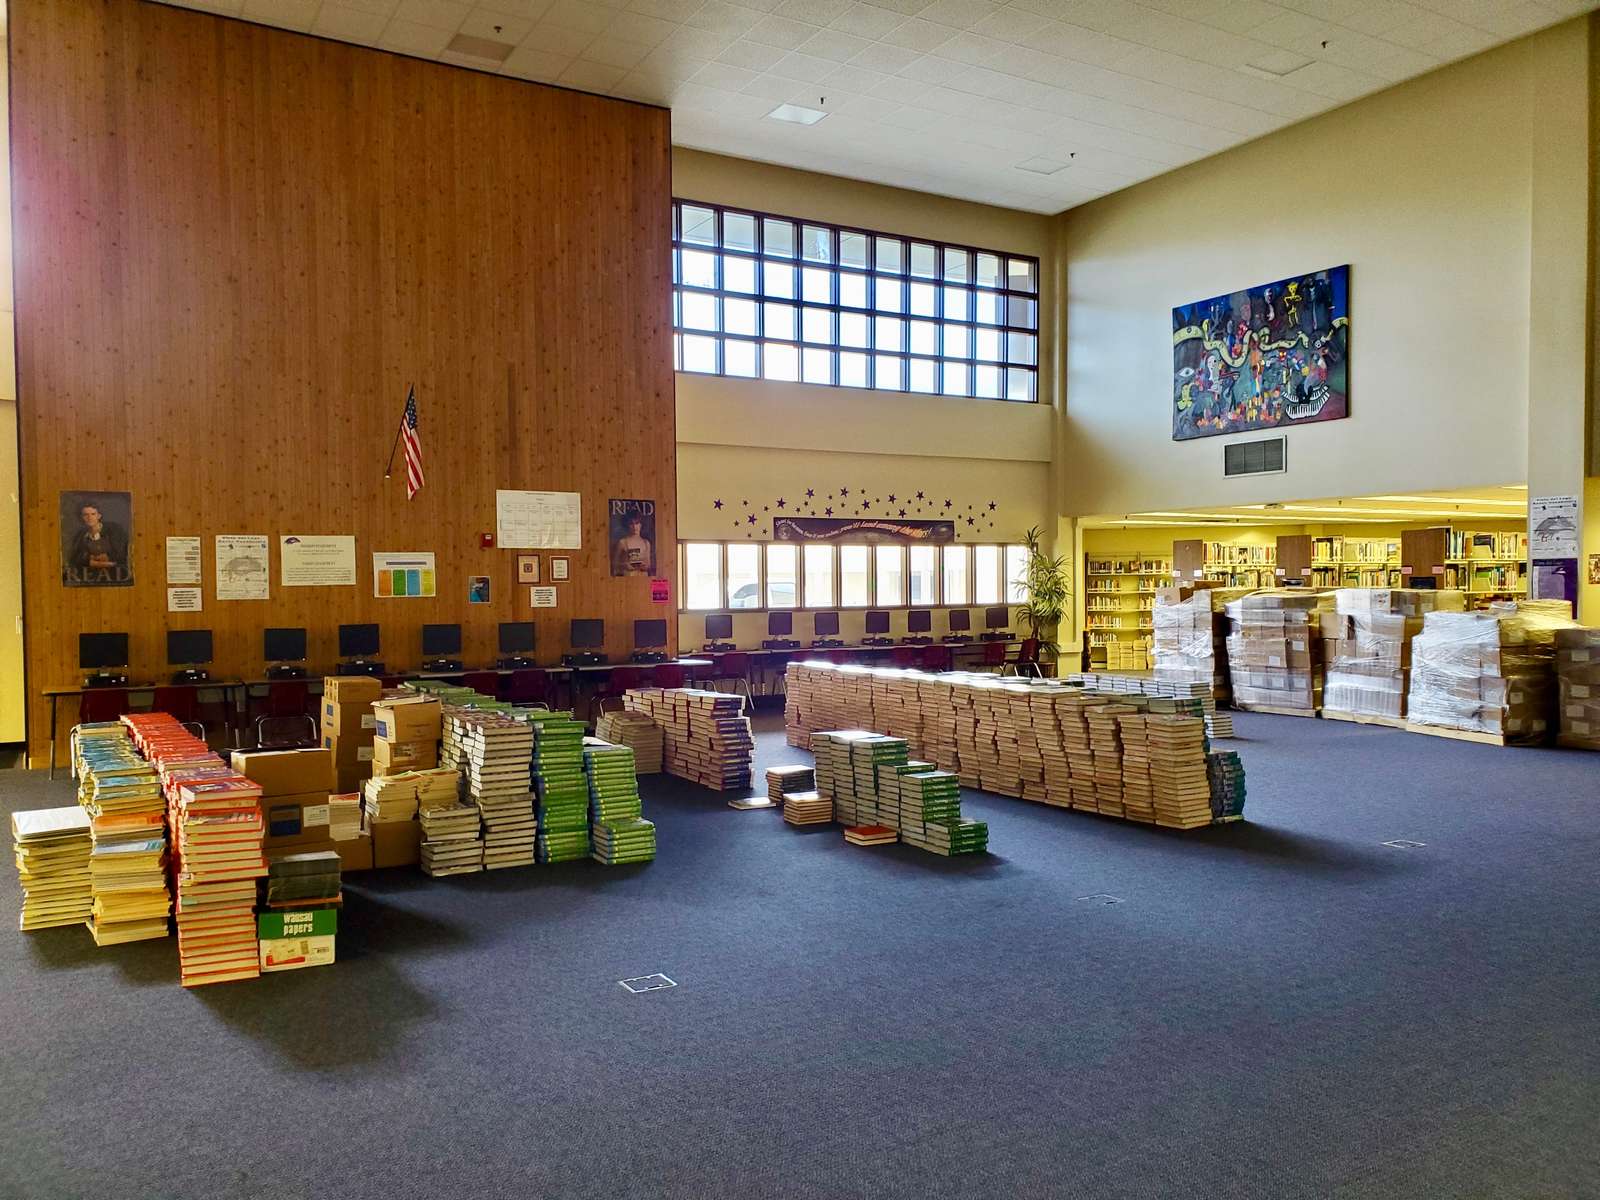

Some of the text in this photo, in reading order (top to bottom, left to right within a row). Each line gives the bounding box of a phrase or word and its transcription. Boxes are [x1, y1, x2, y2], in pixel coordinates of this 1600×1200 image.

[612, 500, 654, 516] READ
[64, 567, 130, 582] READ
[284, 924, 313, 936] papers
